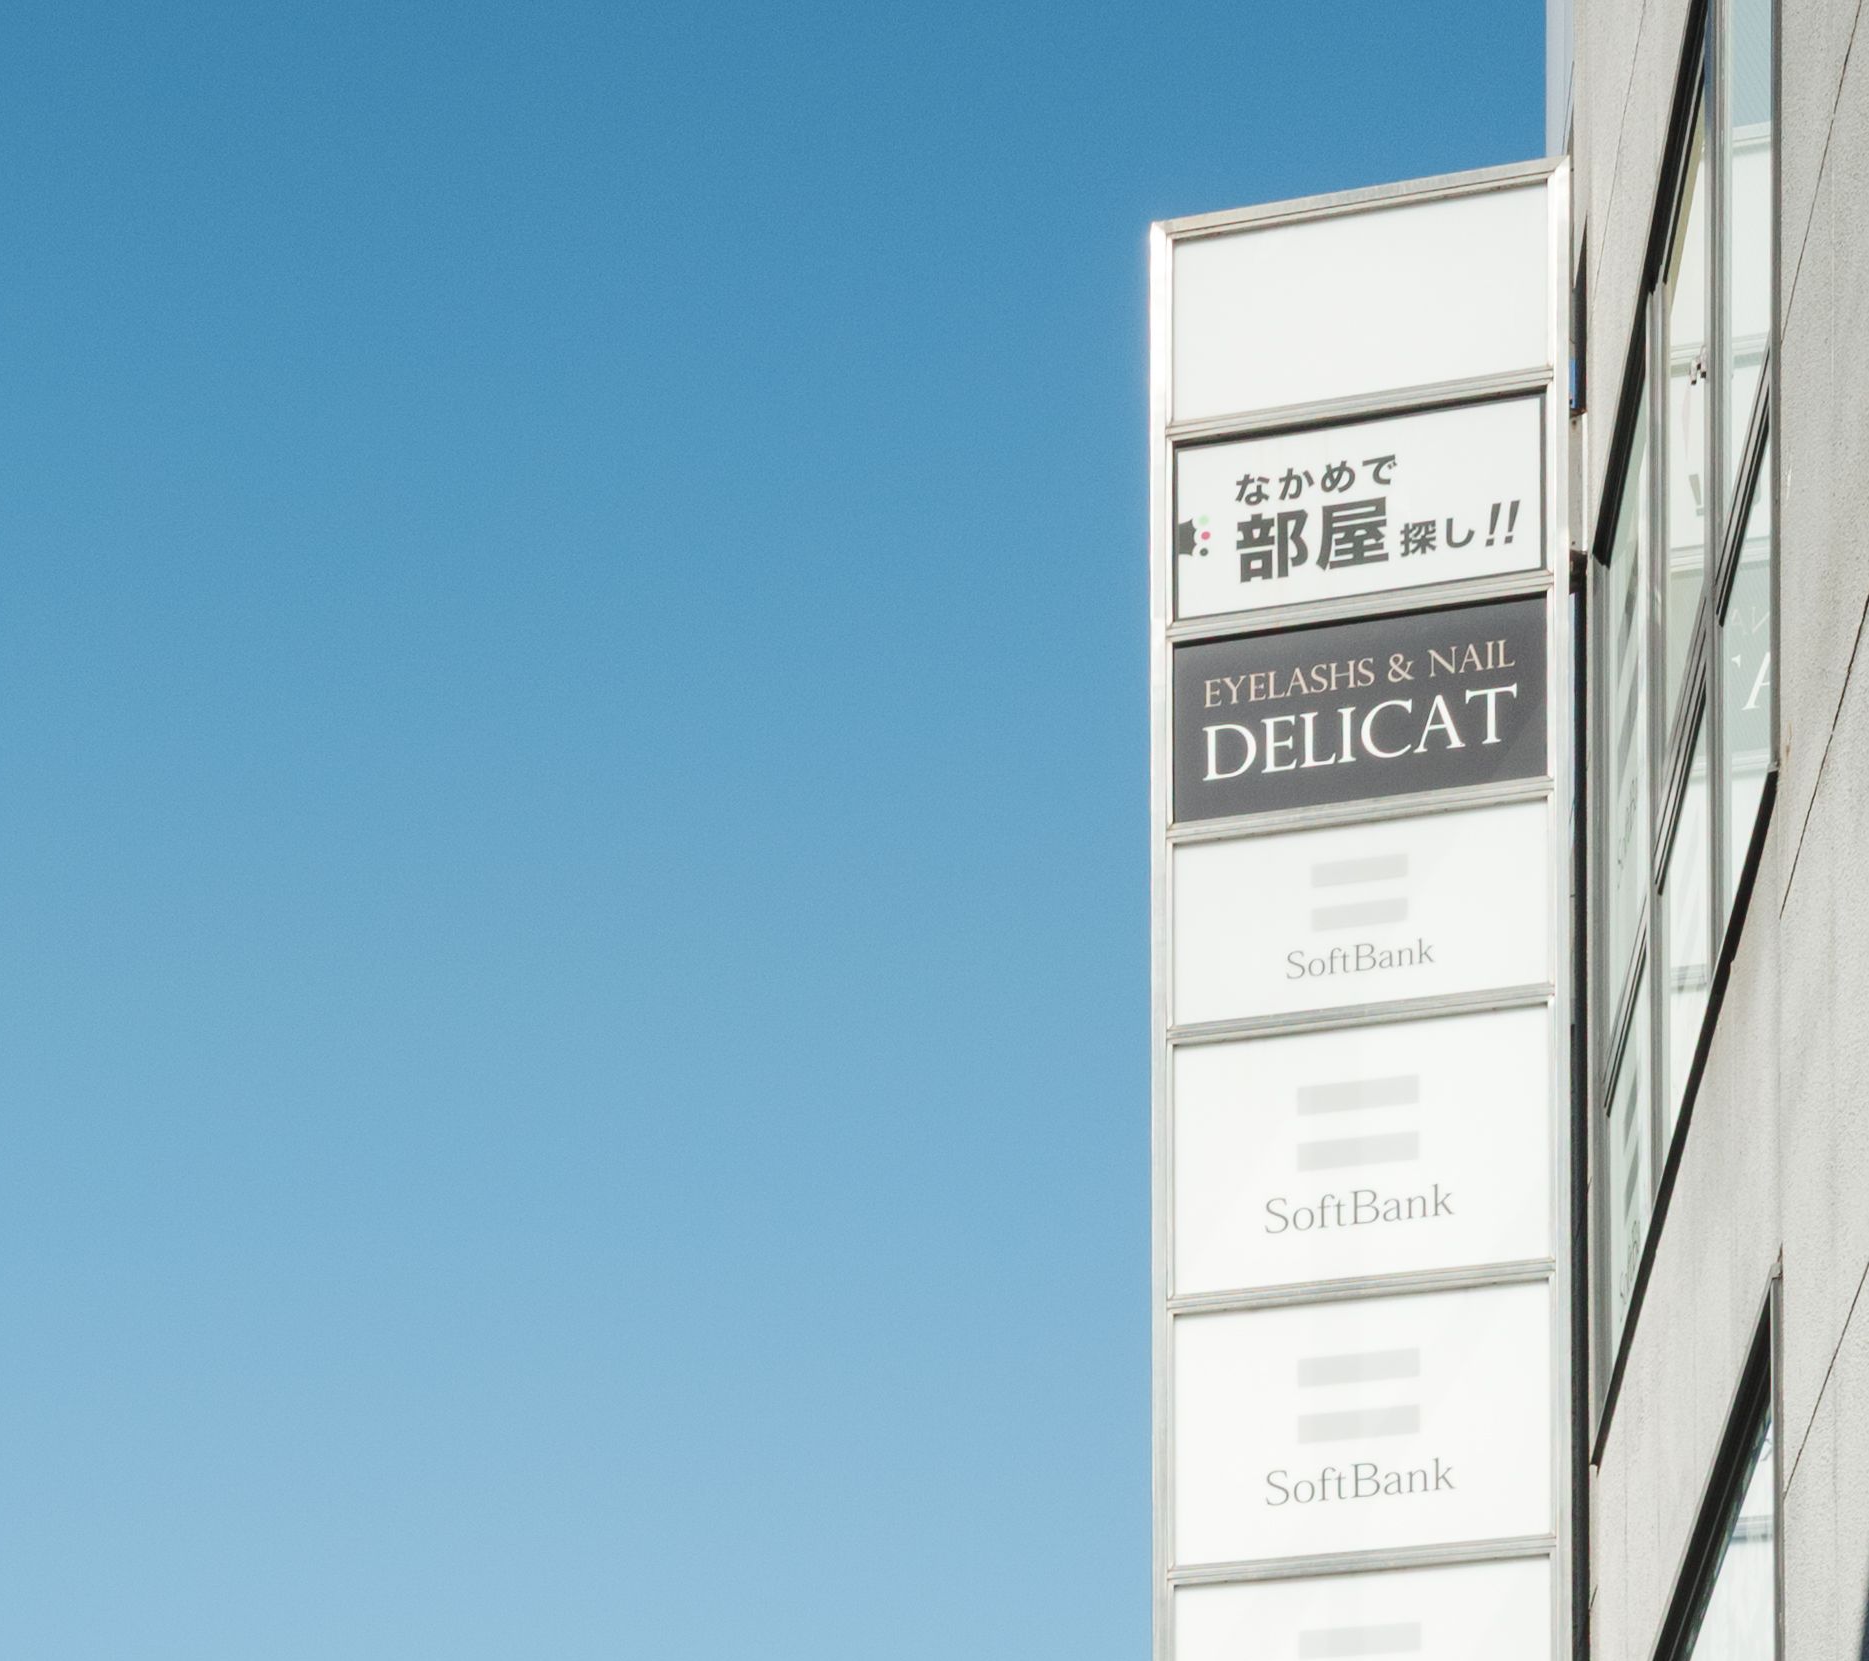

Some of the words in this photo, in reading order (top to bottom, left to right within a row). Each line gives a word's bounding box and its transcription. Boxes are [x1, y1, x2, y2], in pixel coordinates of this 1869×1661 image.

[1235, 454, 1398, 507] なかめで
[1203, 656, 1376, 709] EYELASHS
[1387, 653, 1415, 683] &
[1427, 639, 1517, 679] NAIL
[1202, 683, 1518, 782] DELICAT
[1285, 937, 1436, 981] SoftBank
[1264, 1183, 1455, 1236] SoftBank
[1265, 1457, 1456, 1509] SoftBank
